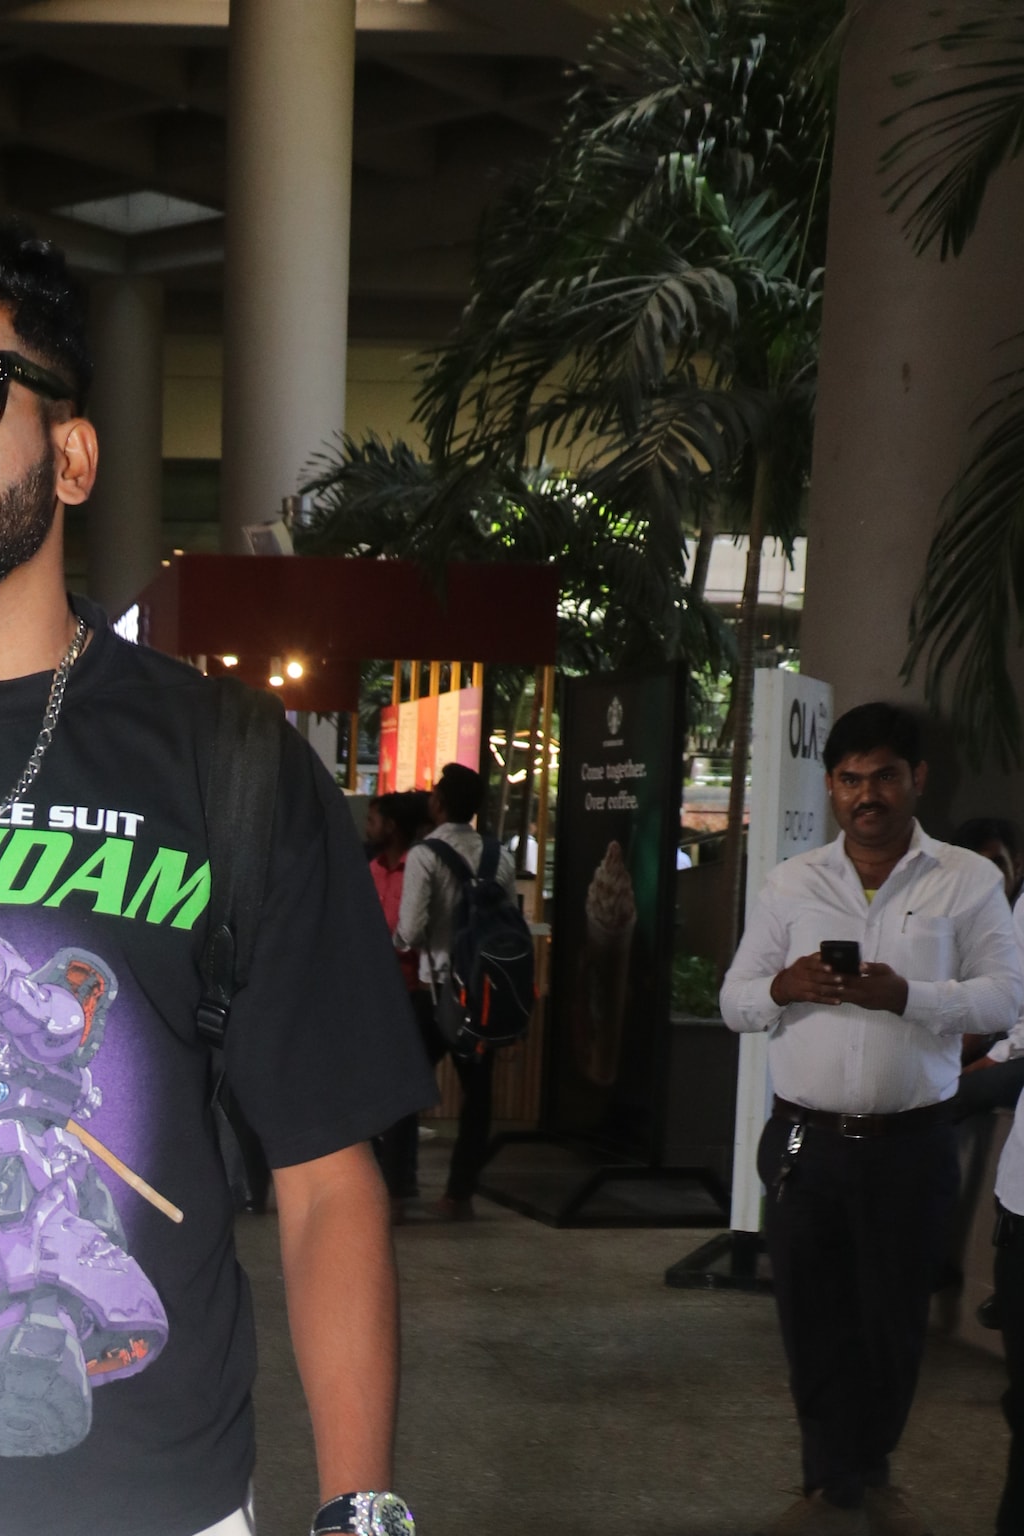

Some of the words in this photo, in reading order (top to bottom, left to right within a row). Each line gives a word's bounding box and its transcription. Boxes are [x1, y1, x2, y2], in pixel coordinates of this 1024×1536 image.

[789, 698, 818, 761] OLA
[581, 763, 604, 780] Come
[606, 759, 647, 784] together.
[585, 792, 606, 811] Over
[607, 790, 639, 810] coffee.
[48, 805, 144, 837] SUIT
[784, 810, 815, 841] PICKUP
